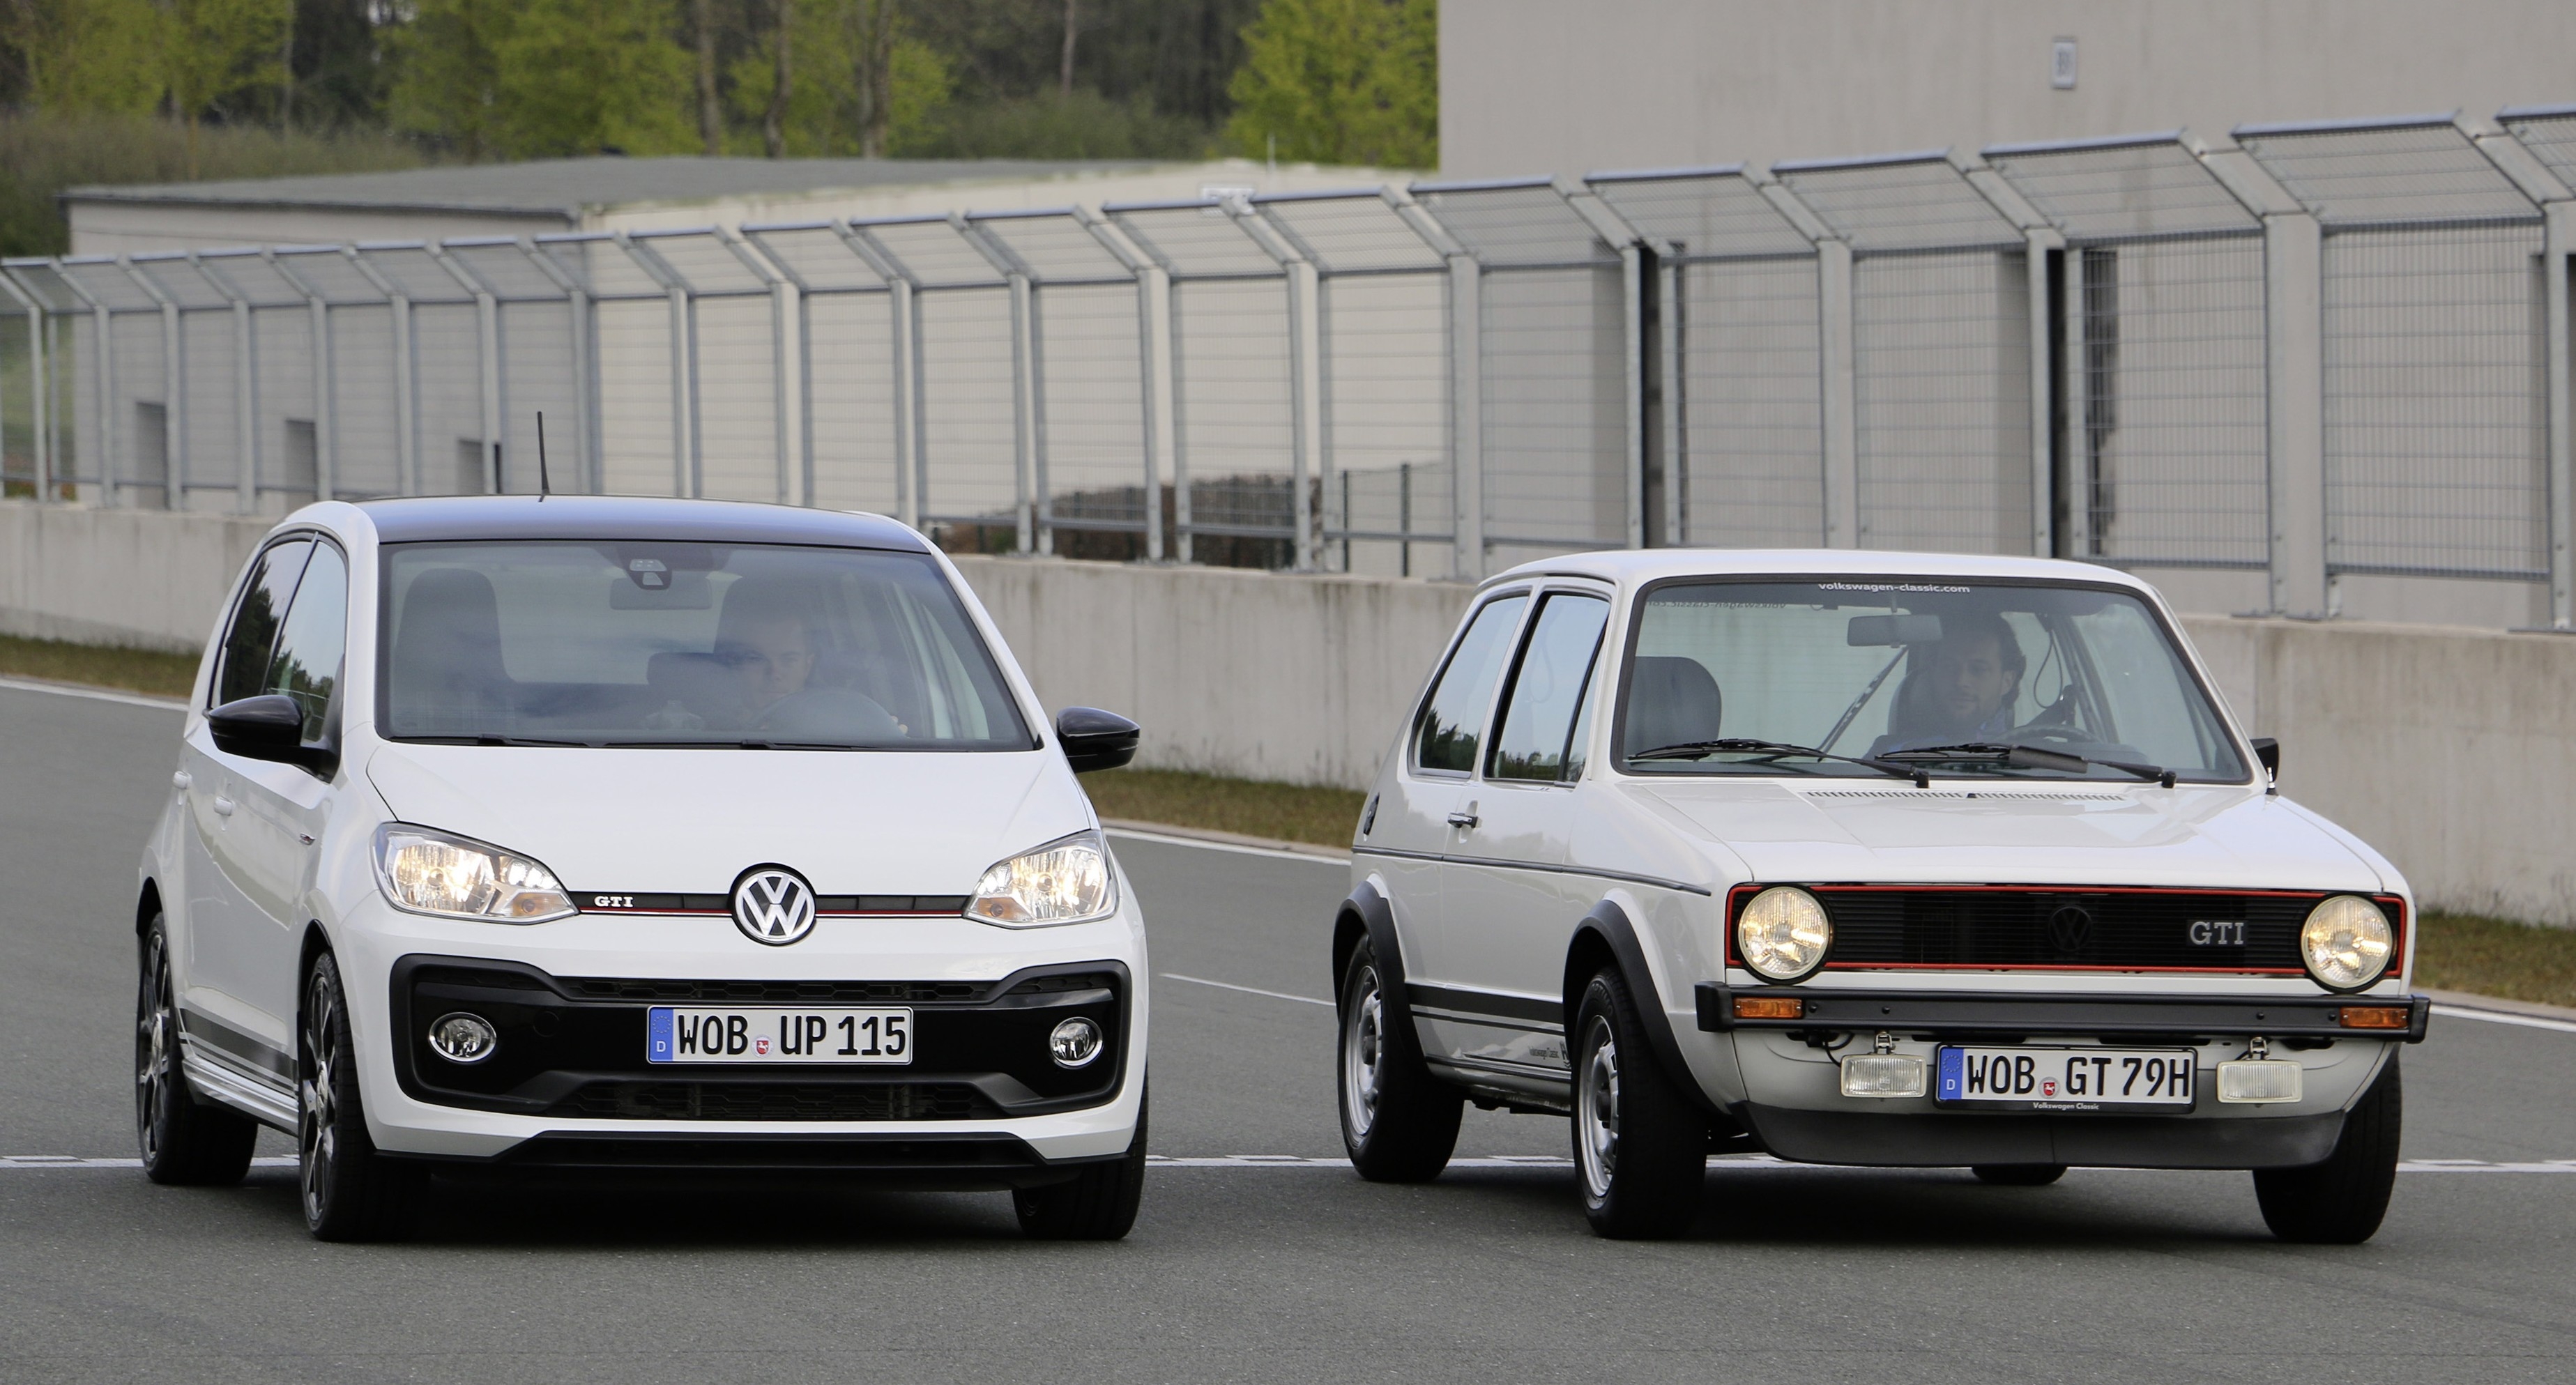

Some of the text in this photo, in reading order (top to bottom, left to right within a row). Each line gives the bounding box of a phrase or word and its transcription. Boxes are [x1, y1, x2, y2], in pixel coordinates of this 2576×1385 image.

[1818, 583, 1970, 592] volkswagen-classic.com
[594, 896, 634, 908] GTI
[736, 871, 815, 943] VW
[2190, 921, 2244, 945] GTI
[678, 1015, 906, 1055] WOB UP 115
[656, 1041, 666, 1053] D
[1967, 1055, 2190, 1097] WOB GT 79H
[1946, 1079, 1956, 1090] D
[2032, 1102, 2075, 1110] Volkswagen
